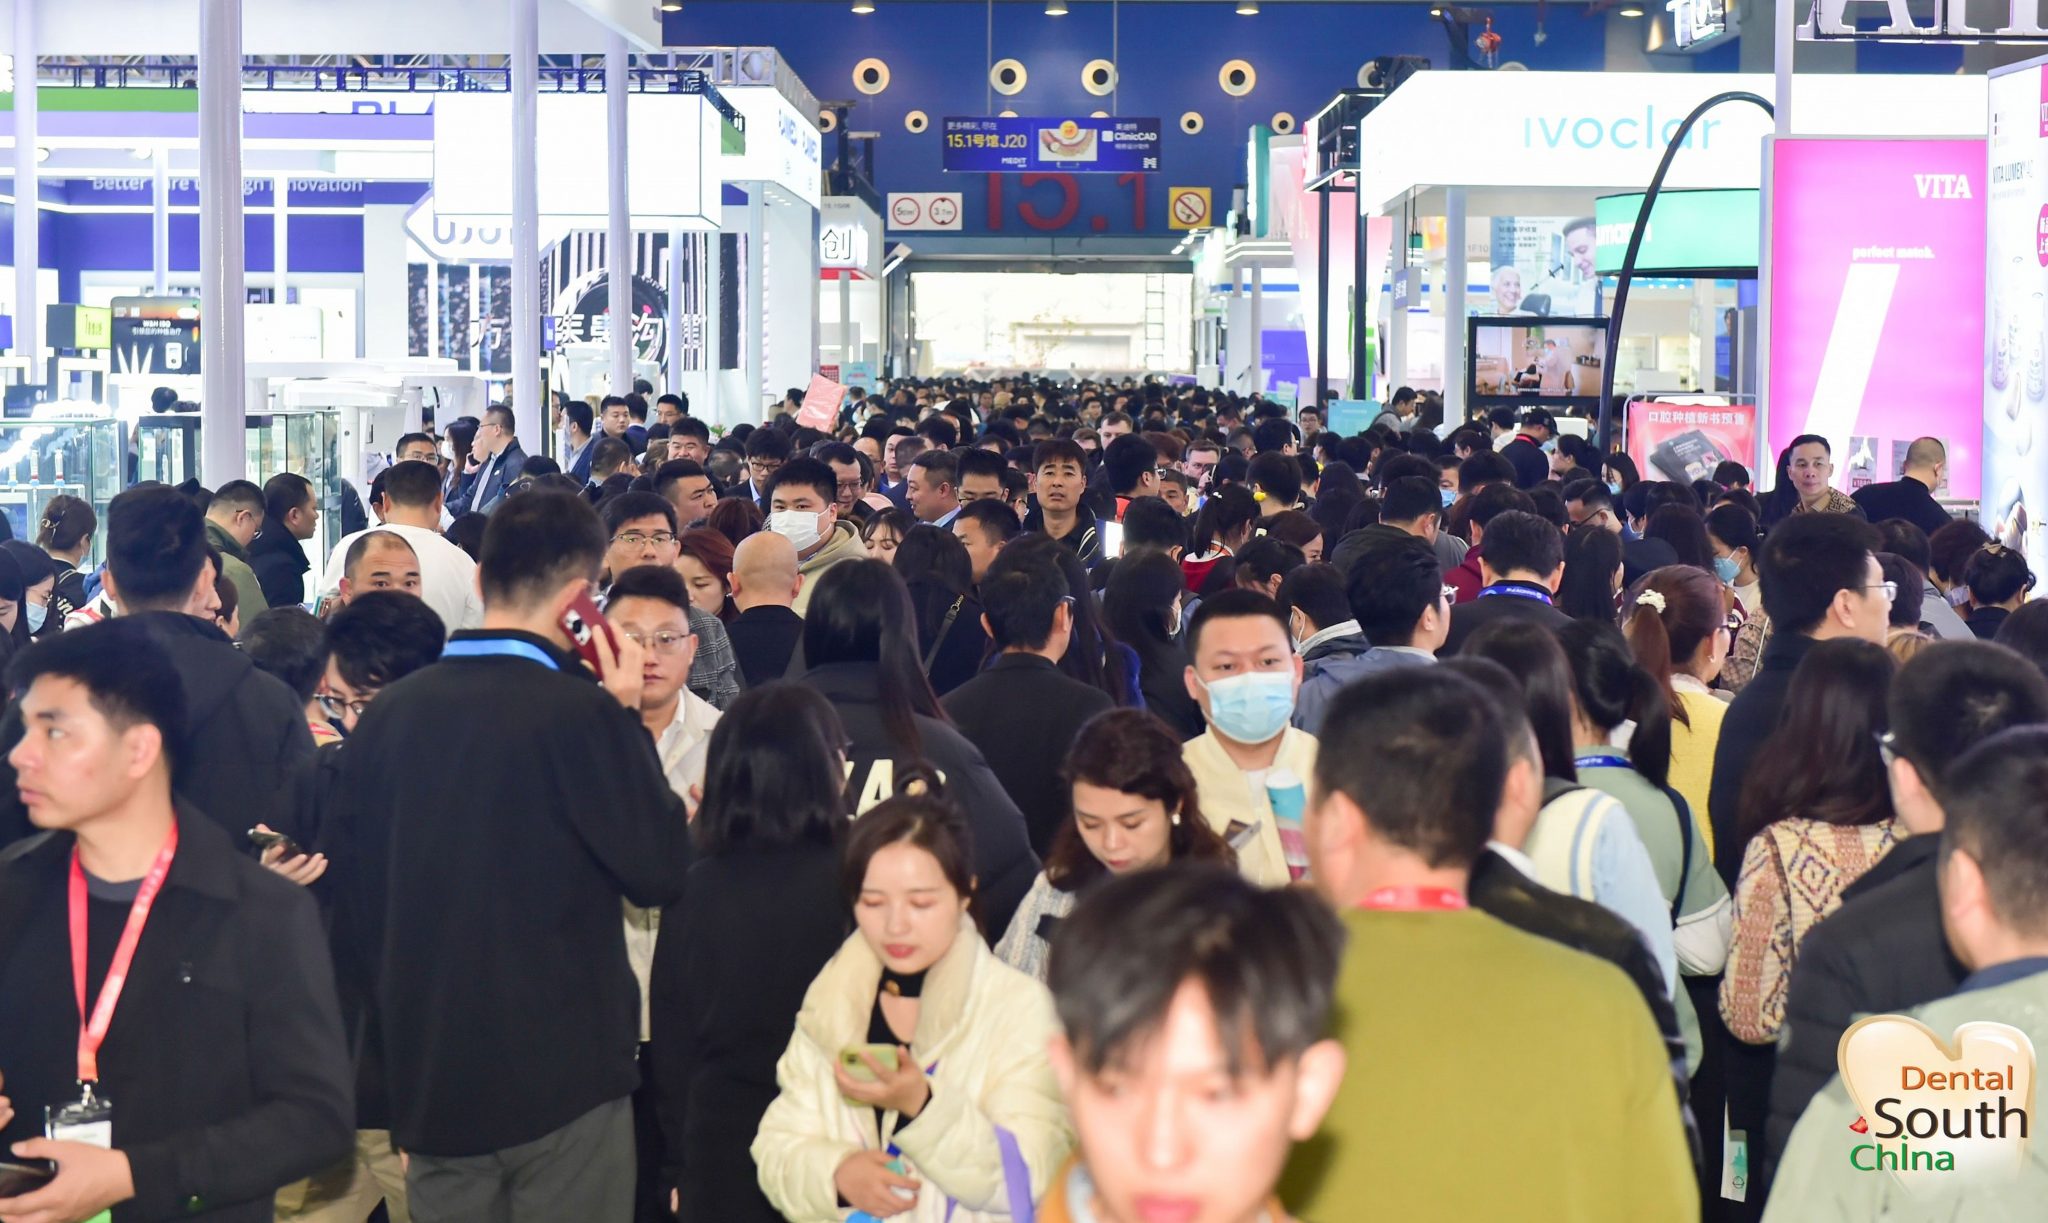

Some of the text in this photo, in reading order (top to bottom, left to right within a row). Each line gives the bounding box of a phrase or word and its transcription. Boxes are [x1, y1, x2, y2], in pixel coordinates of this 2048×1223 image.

[1001, 134, 1027, 148] J20
[1115, 132, 1157, 141] ClinicCAD
[1914, 174, 1973, 199] VITA
[1853, 245, 1895, 260] perfect
[1648, 411, 1745, 425] 口腔种植新书预售
